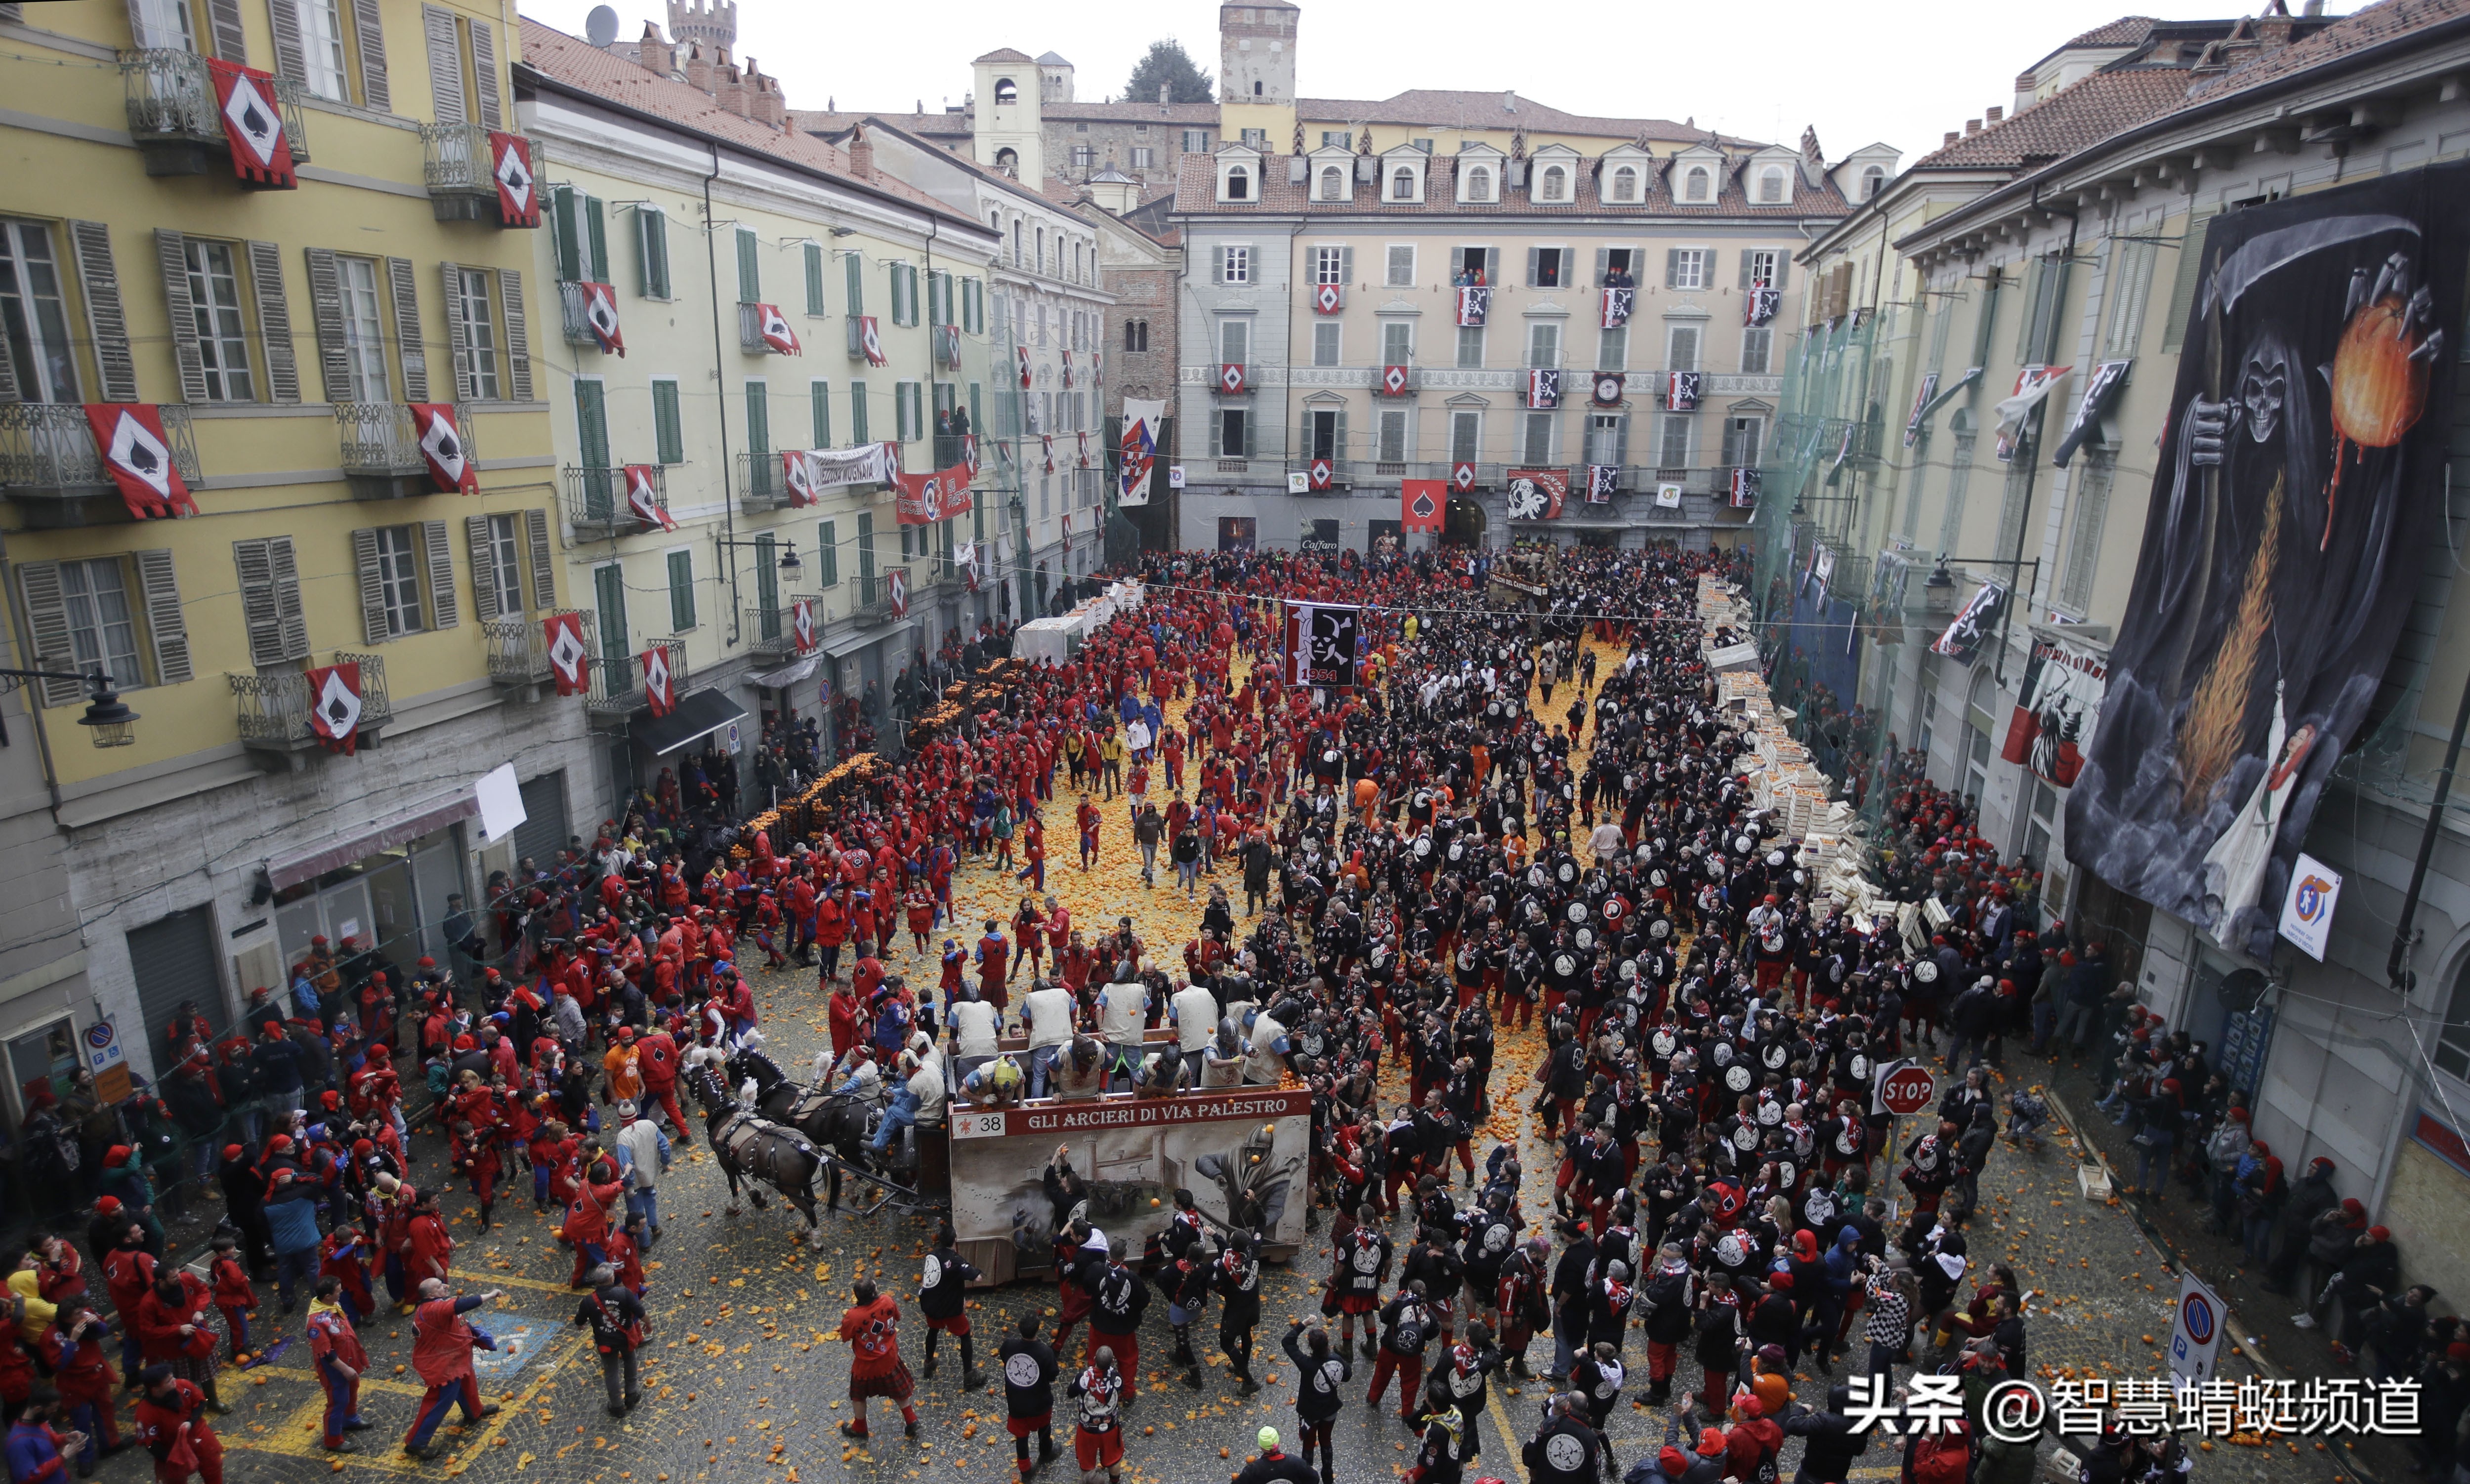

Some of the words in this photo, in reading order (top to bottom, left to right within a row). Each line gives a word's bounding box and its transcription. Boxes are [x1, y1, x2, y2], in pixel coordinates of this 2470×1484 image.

[818, 466, 842, 486] VEZZOSA
[842, 462, 874, 483] MUGNAIA
[947, 478, 956, 494] NO
[1539, 473, 1566, 492] FONDO
[947, 486, 972, 509] PARTY
[1543, 481, 1562, 506] PIAZZA
[1302, 539, 1337, 551] Caffaro
[1942, 641, 1965, 656] 195
[1301, 668, 1337, 682] 1954
[2286, 929, 2298, 941] VARCO
[2305, 932, 2314, 942] OUT
[1028, 1114, 1058, 1129] GLI
[1063, 1110, 1135, 1127] ARCIERI
[1140, 1108, 1157, 1121] DI
[1161, 1104, 1193, 1120] VIA
[1198, 1099, 1288, 1117] PALESTRO
[980, 1116, 1001, 1132] 38
[1353, 1276, 1367, 1288] MOTO
